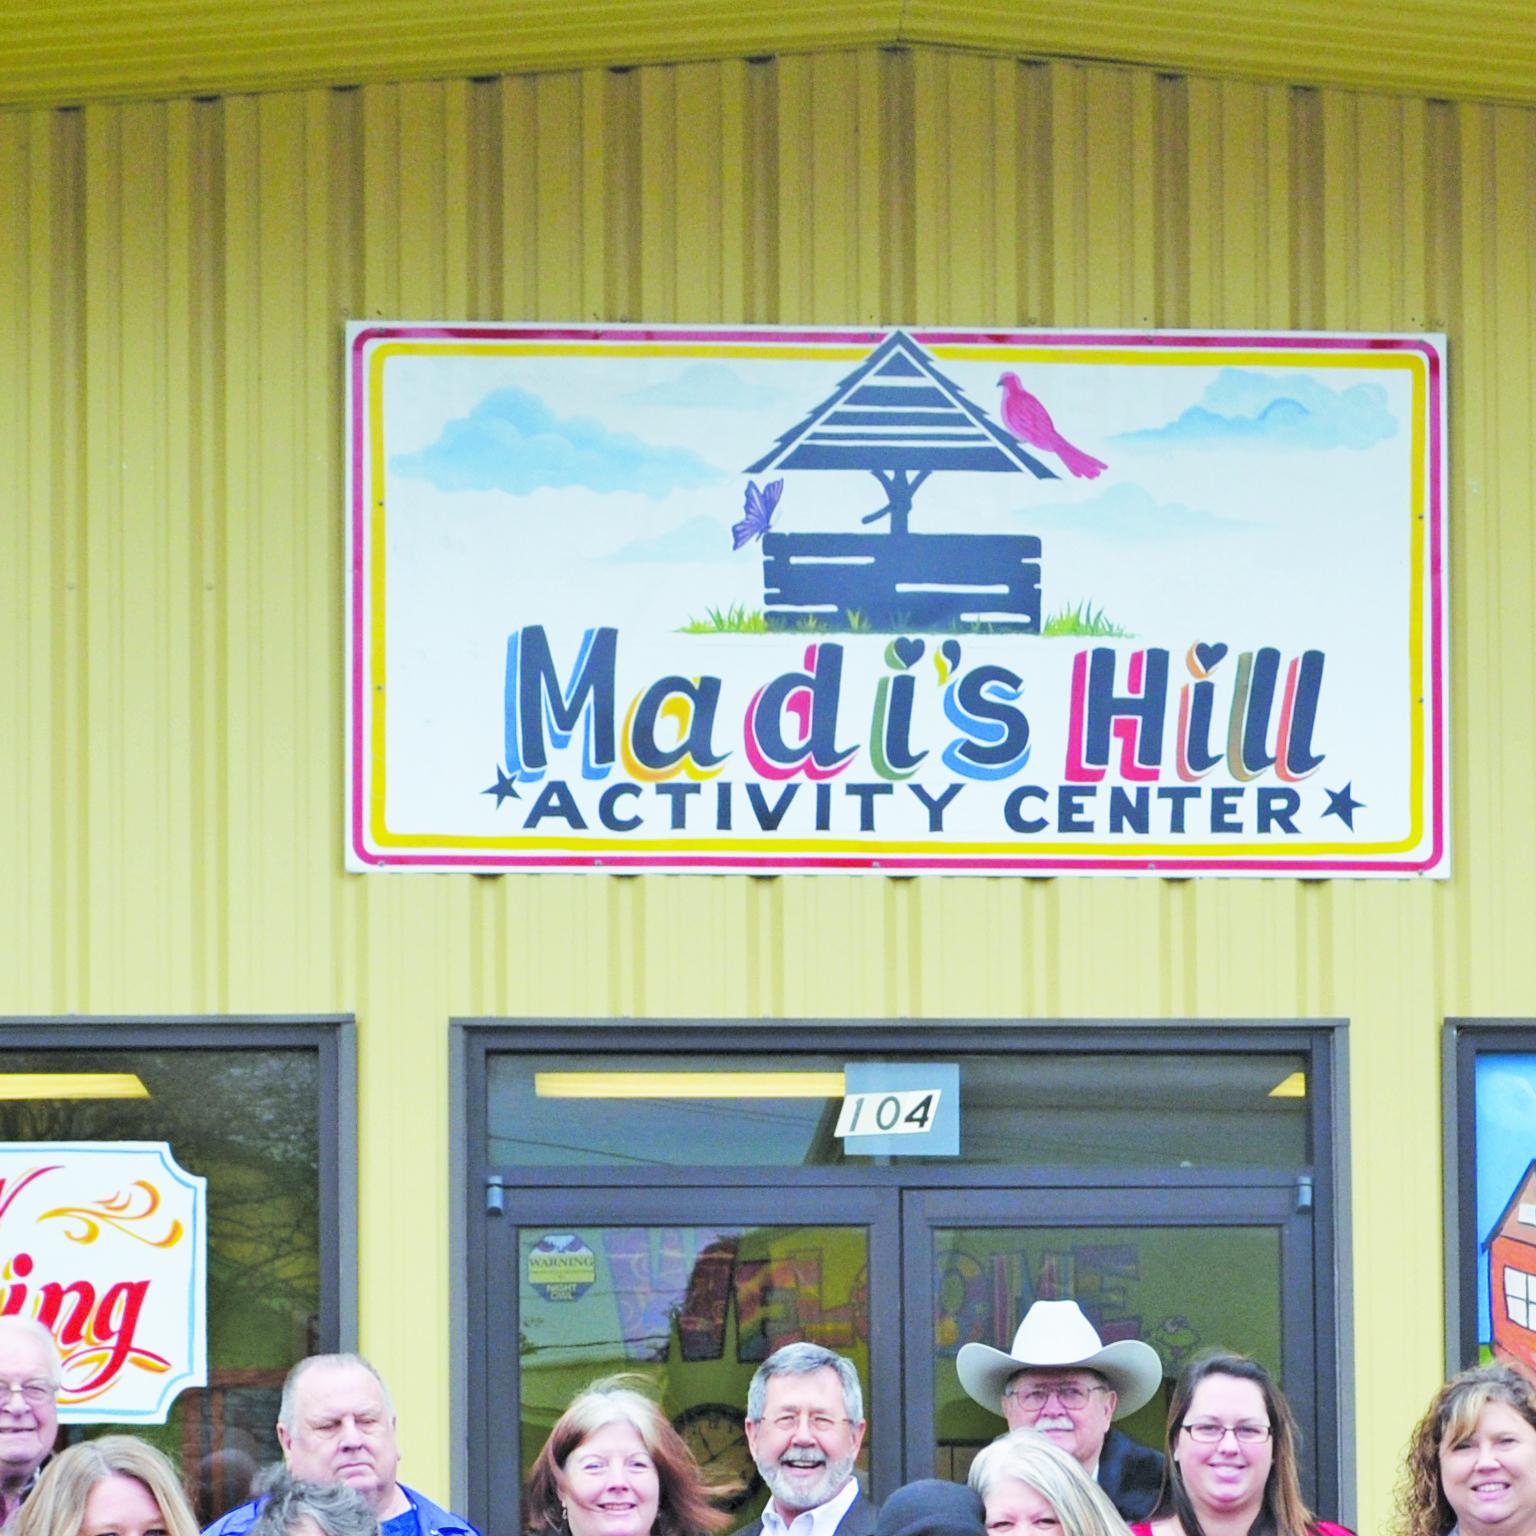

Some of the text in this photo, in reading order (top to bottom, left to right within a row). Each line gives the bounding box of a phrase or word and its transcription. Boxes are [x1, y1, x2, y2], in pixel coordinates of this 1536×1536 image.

[505, 625, 1326, 783] Madi's Hill
[522, 780, 1303, 835] ACTIVITY CENTER
[848, 1094, 934, 1132] 104
[530, 1256, 593, 1268] WARNING
